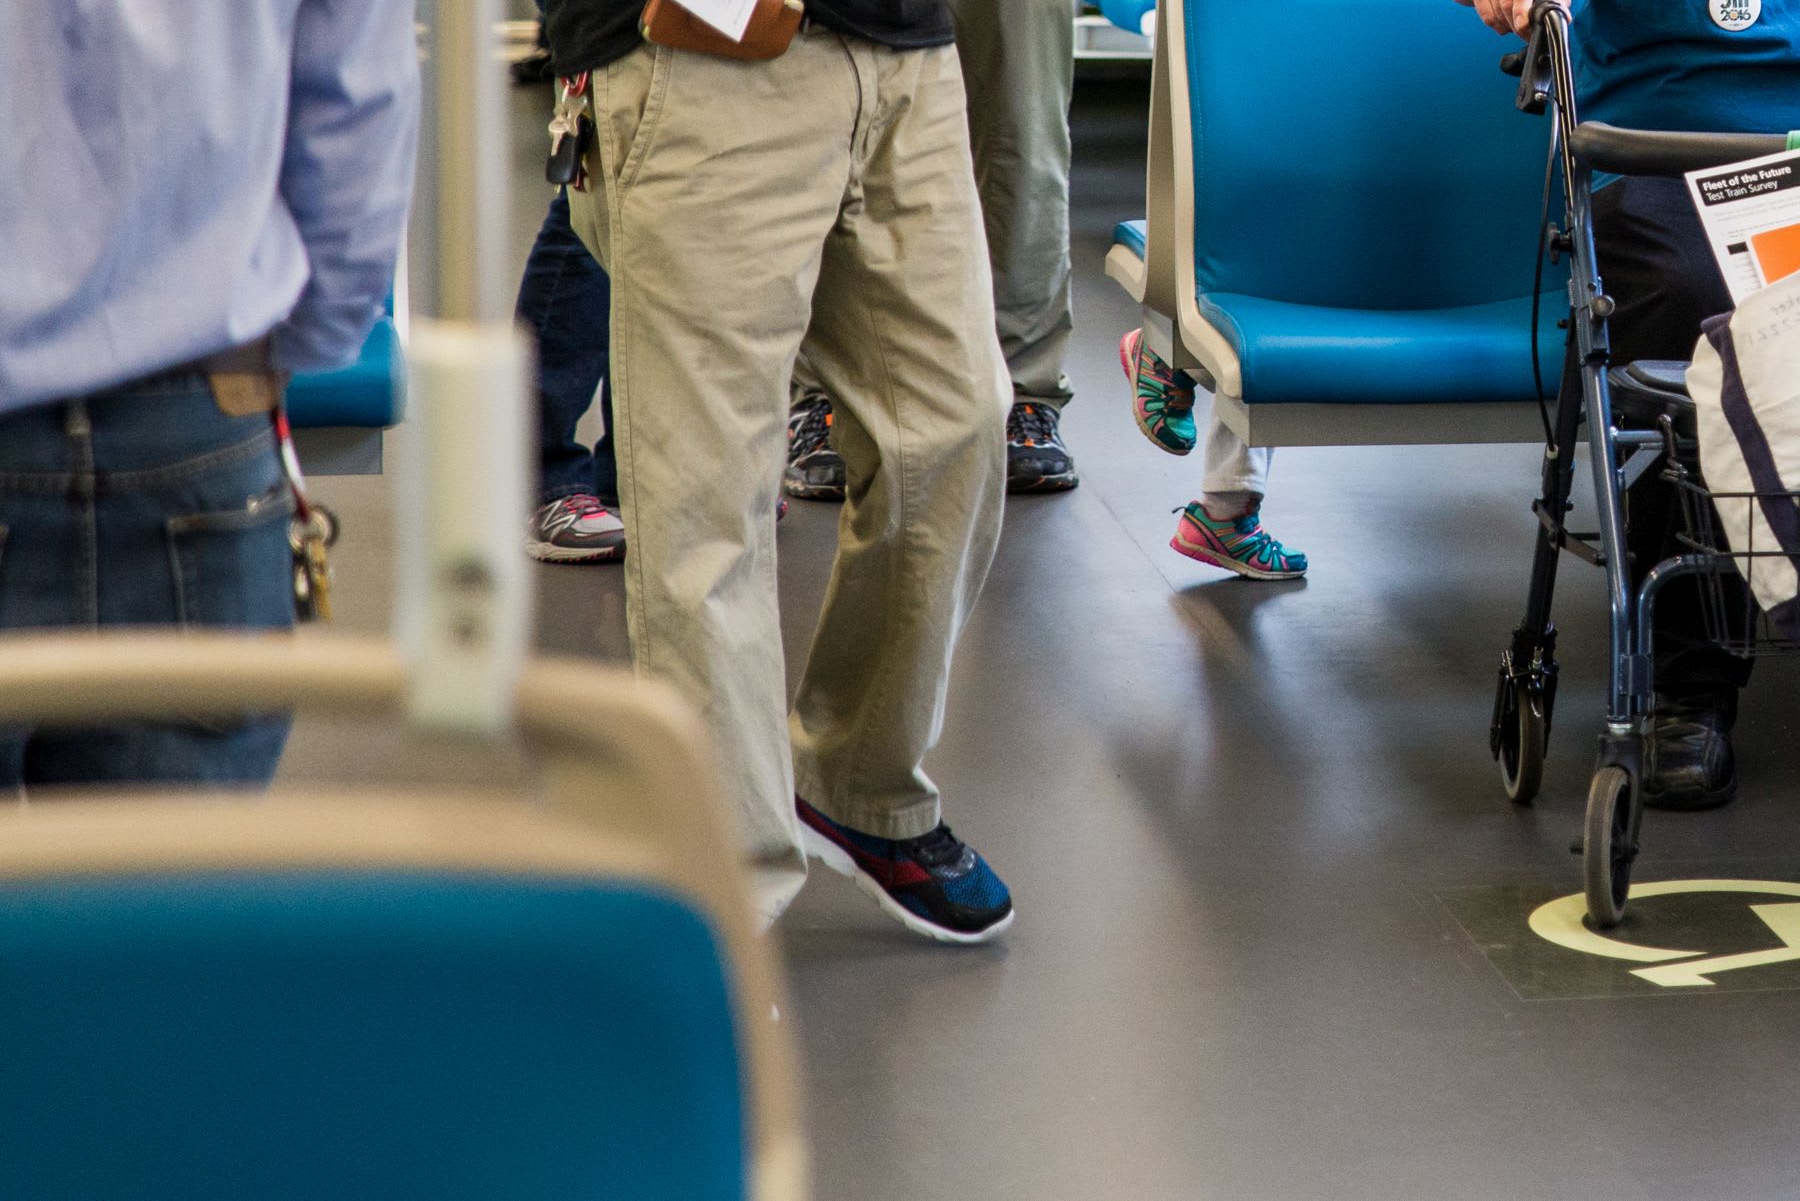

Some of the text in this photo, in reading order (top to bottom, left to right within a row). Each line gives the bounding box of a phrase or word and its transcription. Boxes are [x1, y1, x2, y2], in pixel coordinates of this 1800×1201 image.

[1721, 9, 1751, 22] 2016
[1703, 165, 1792, 193] Fleet of the Future
[1705, 188, 1725, 203] Test
[1725, 184, 1748, 198] Train
[1749, 178, 1778, 195] Survey
